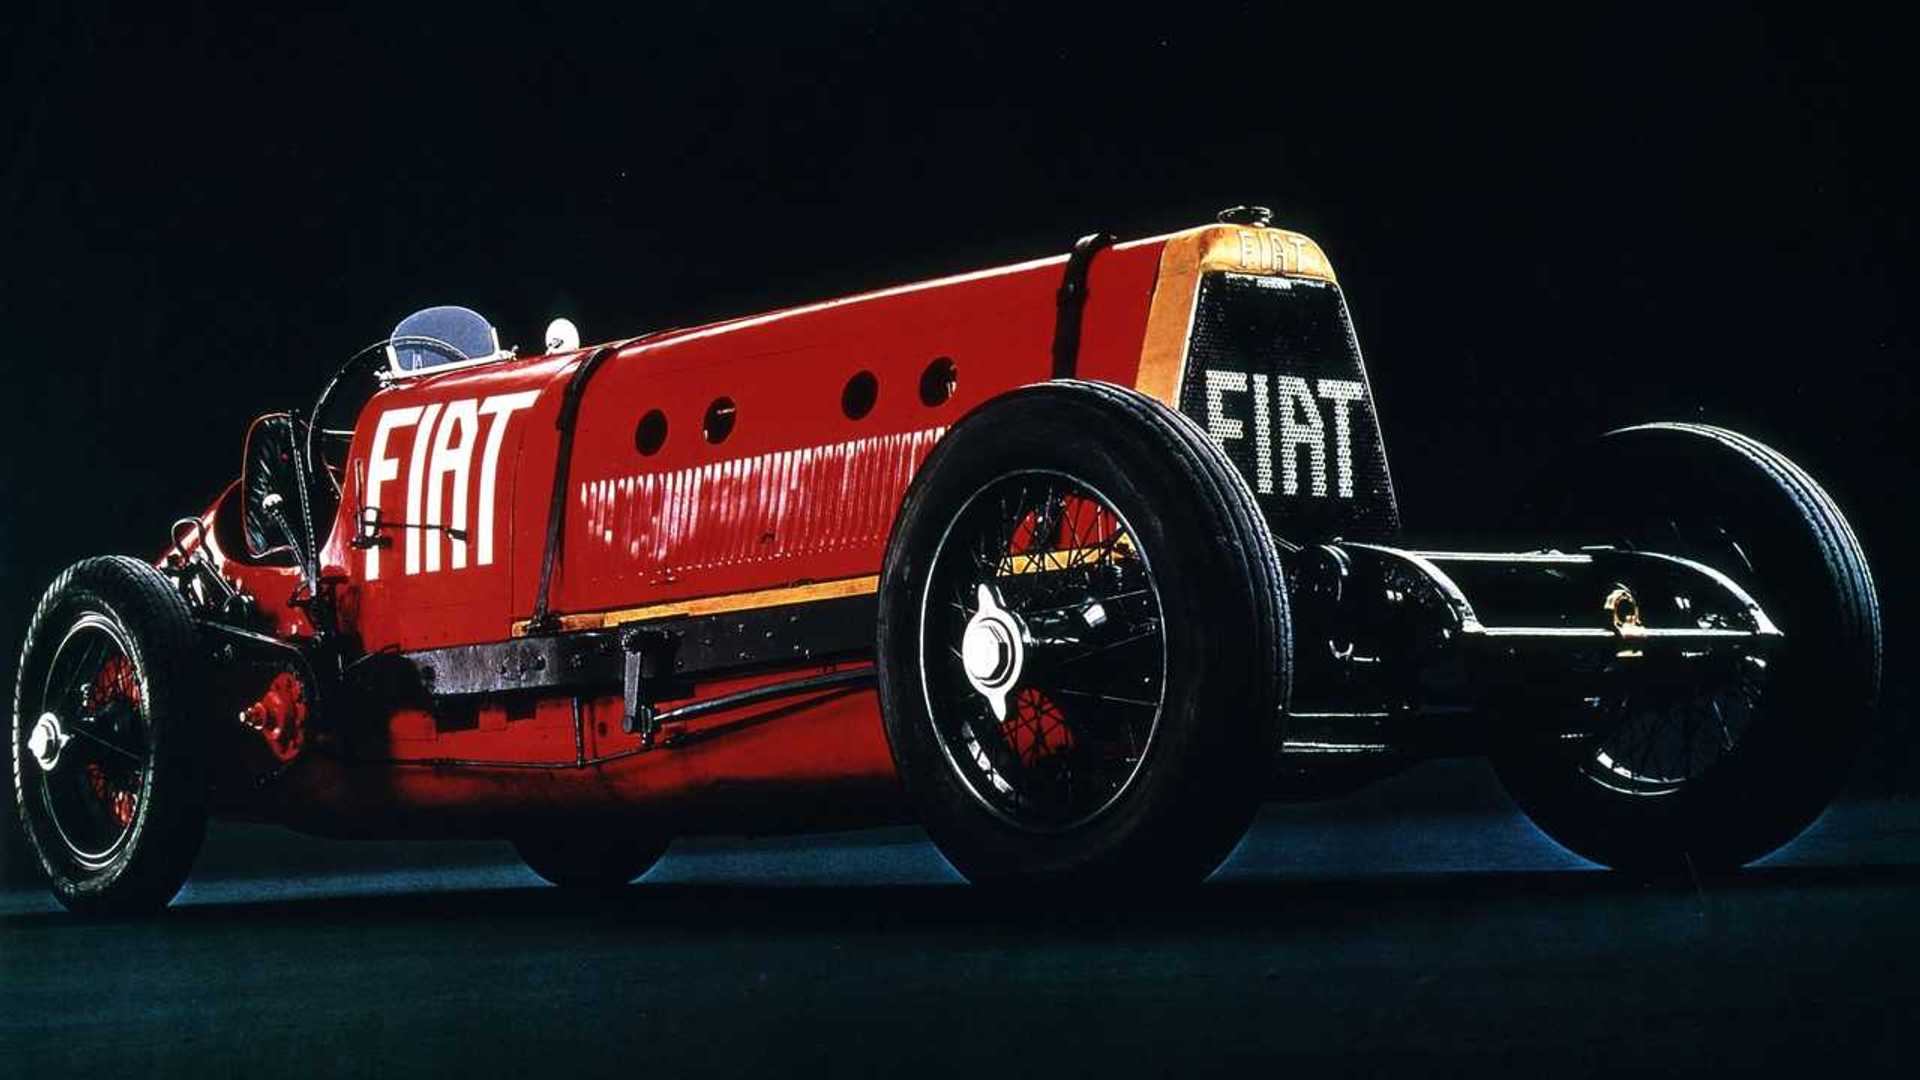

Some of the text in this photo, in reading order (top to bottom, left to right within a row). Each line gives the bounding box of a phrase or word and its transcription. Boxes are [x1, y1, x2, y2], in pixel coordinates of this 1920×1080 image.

[1238, 229, 1309, 272] FIAT
[364, 389, 542, 582] FIAT
[1205, 370, 1364, 498] FIAT
